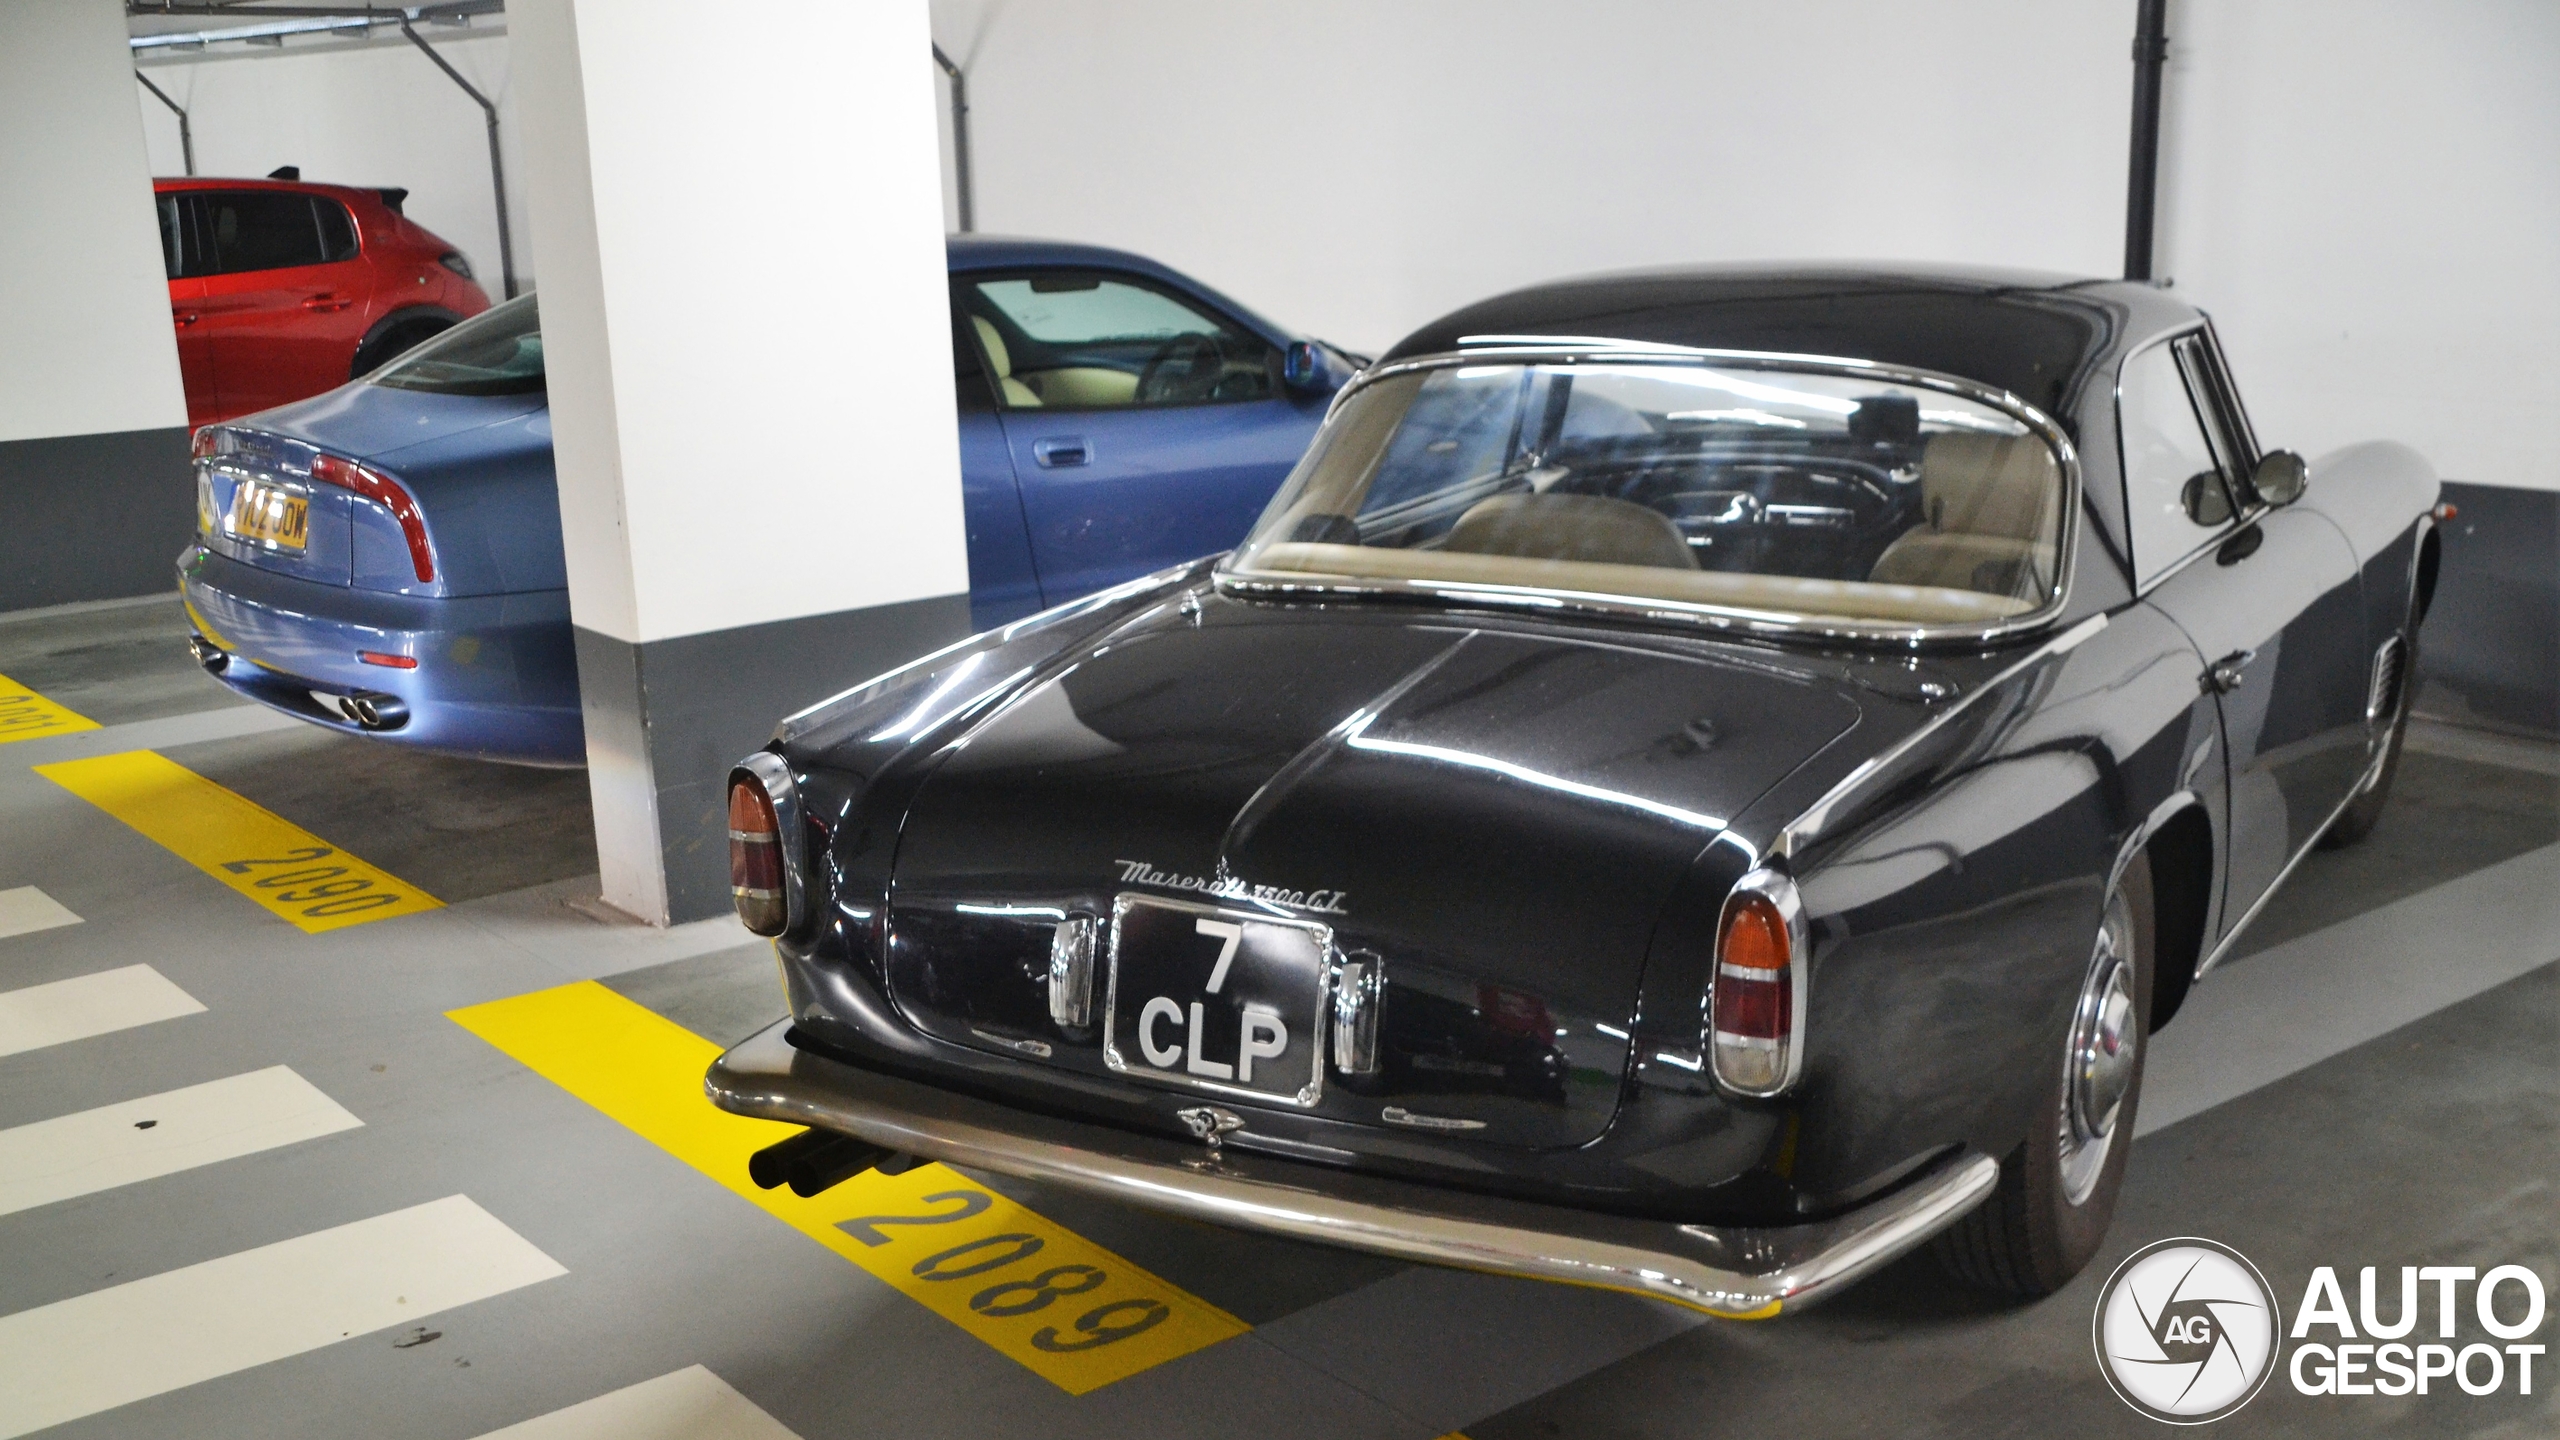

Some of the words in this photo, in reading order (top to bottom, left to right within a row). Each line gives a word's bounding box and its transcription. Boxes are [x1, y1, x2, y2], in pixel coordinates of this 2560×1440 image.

[220, 847, 402, 917] 2090
[1115, 859, 1247, 901] Maserati
[1252, 884, 1306, 910] 3500
[1195, 918, 1242, 994] 7
[1138, 996, 1289, 1082] CLP
[832, 1189, 1171, 1353] 2089
